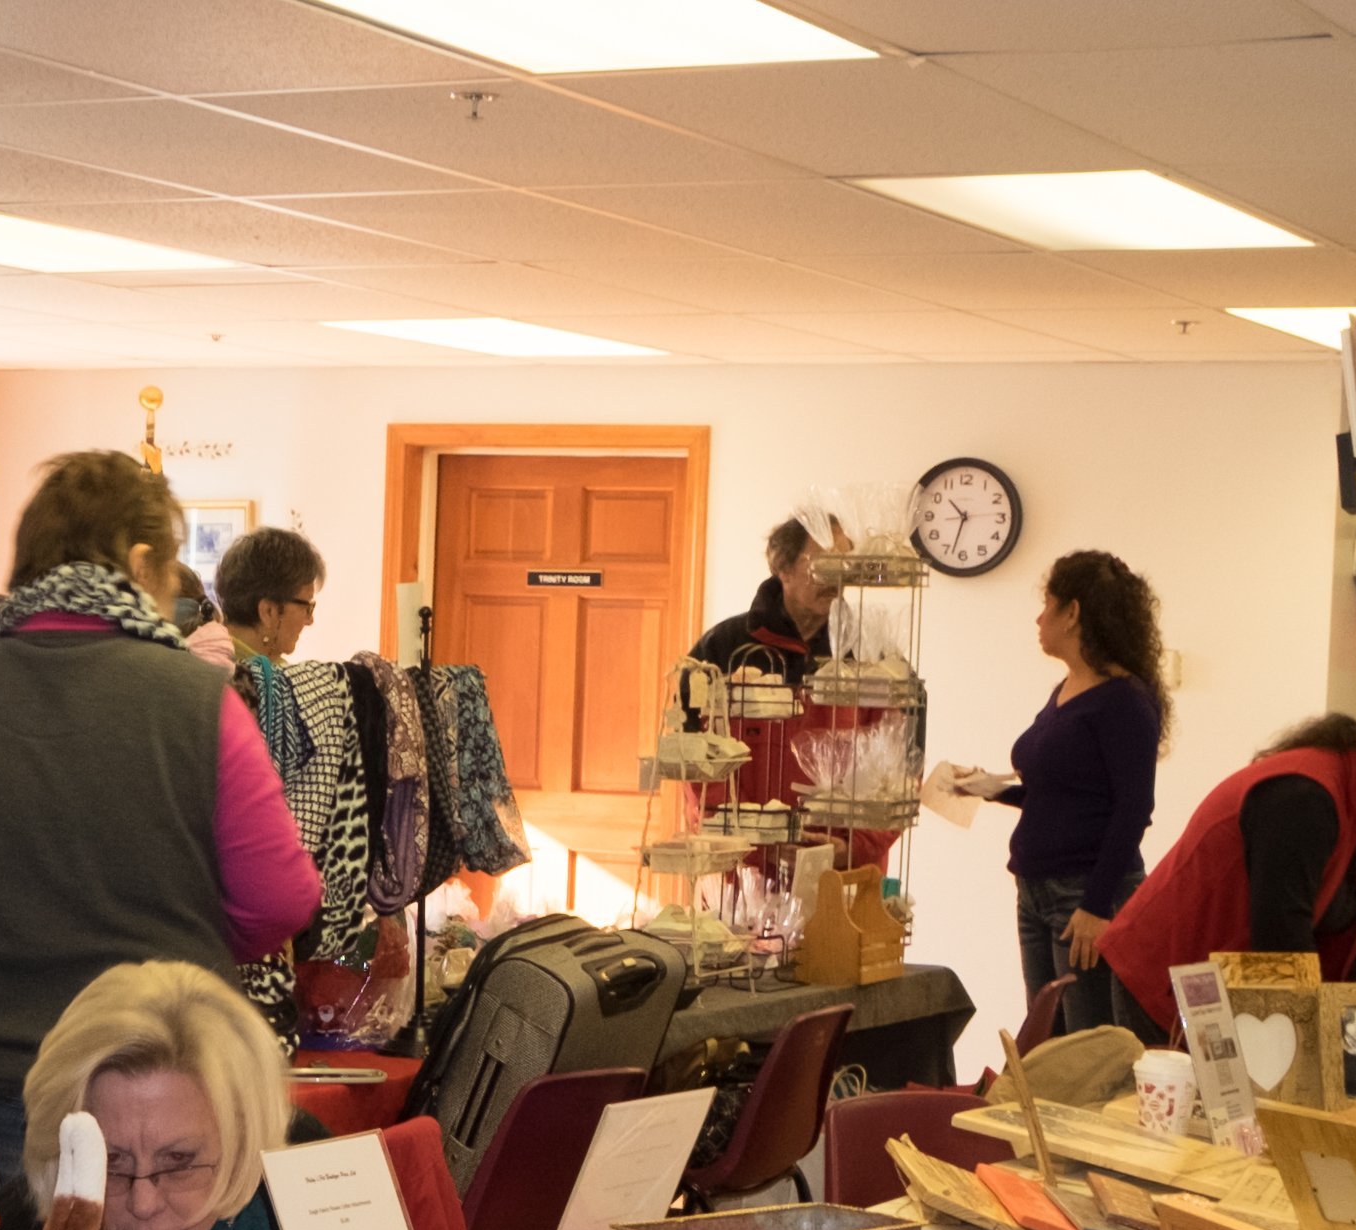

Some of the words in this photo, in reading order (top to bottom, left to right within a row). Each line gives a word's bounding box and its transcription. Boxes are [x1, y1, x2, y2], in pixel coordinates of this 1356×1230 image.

[943, 479, 954, 490] 11
[960, 474, 973, 486] 12
[992, 493, 1002, 504] 2
[924, 510, 935, 522] 9
[996, 512, 1006, 524] 3
[929, 529, 940, 541] 8
[991, 531, 1000, 541] 4
[942, 544, 951, 555] 7
[977, 545, 988, 556] 5
[958, 550, 968, 561] 6
[538, 574, 567, 584] TRINITY
[567, 574, 591, 584] ROOM
